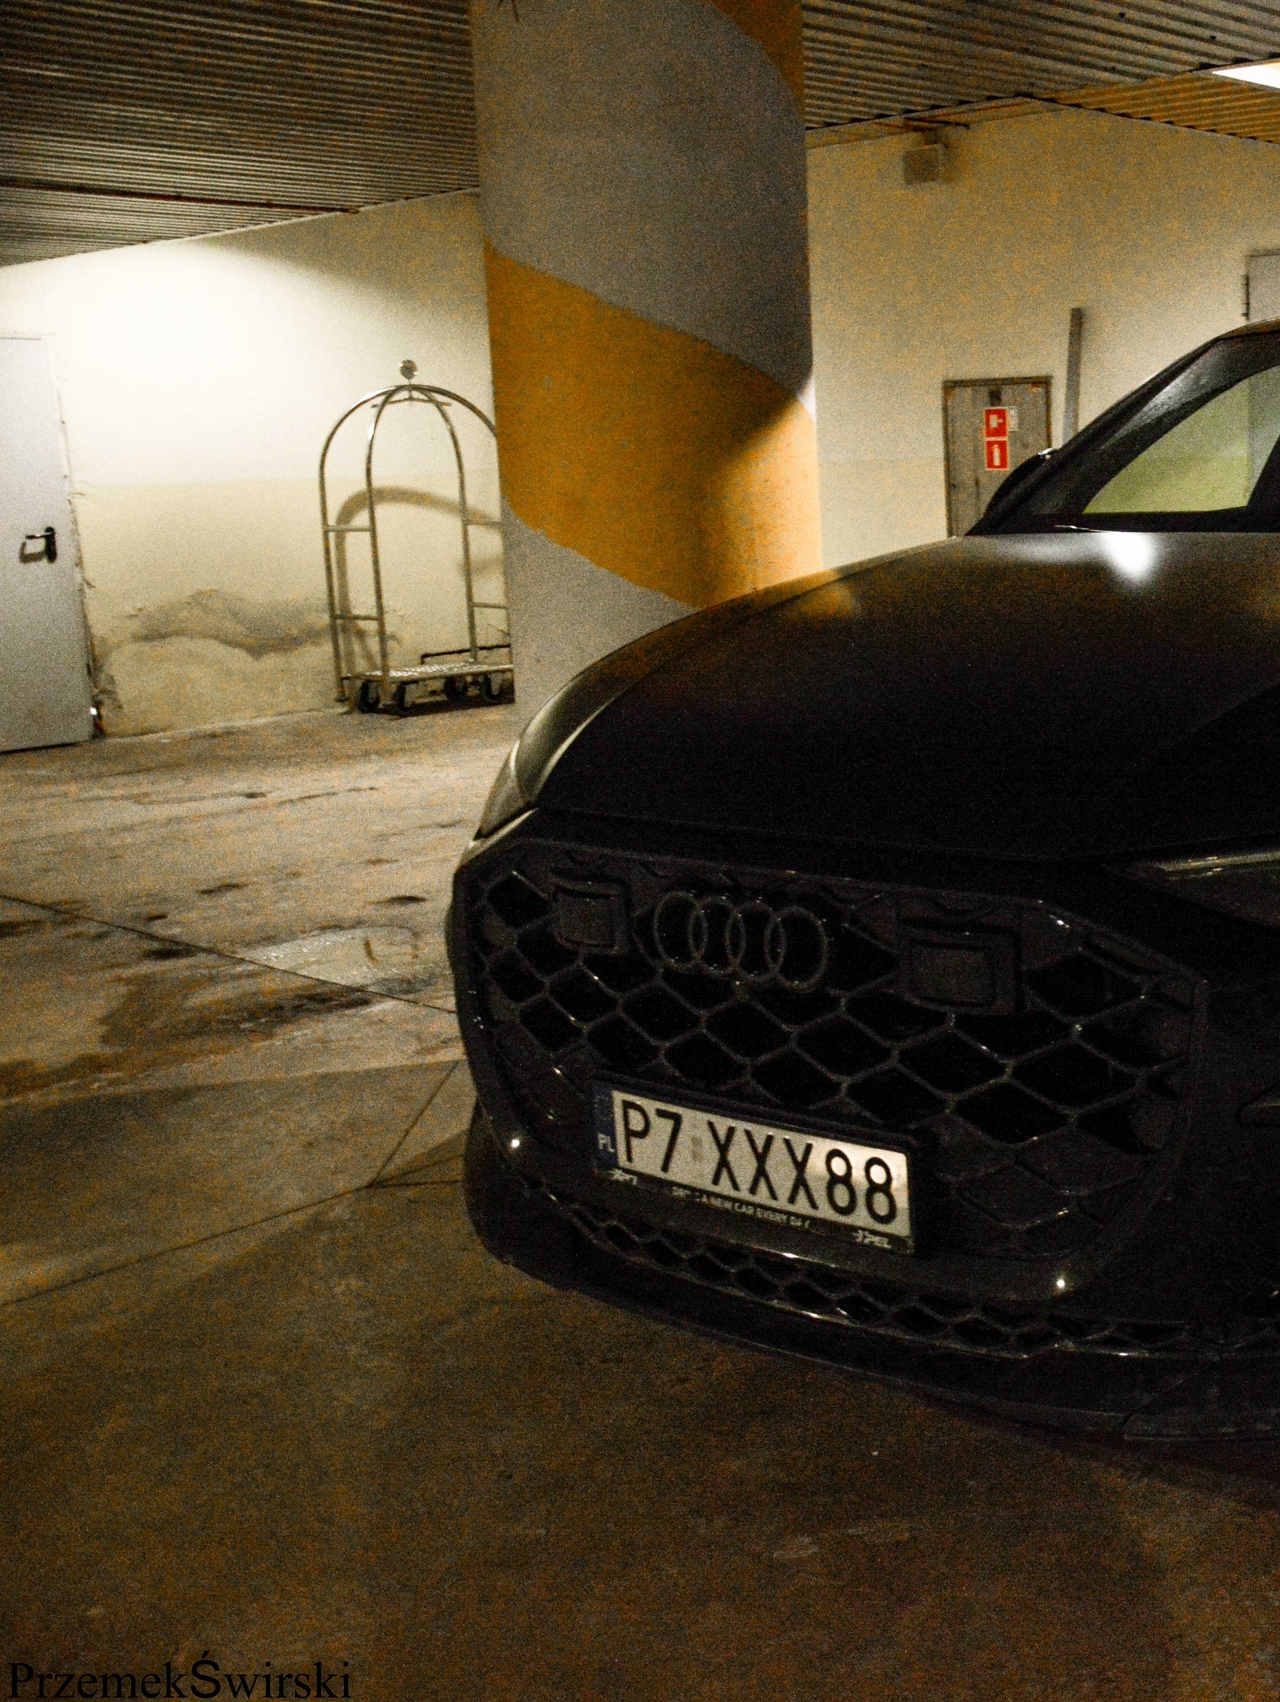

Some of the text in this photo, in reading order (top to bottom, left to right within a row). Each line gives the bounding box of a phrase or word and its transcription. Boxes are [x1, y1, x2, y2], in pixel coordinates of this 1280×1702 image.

[597, 1133, 614, 1152] PL
[621, 1100, 897, 1224] P7 XXX88
